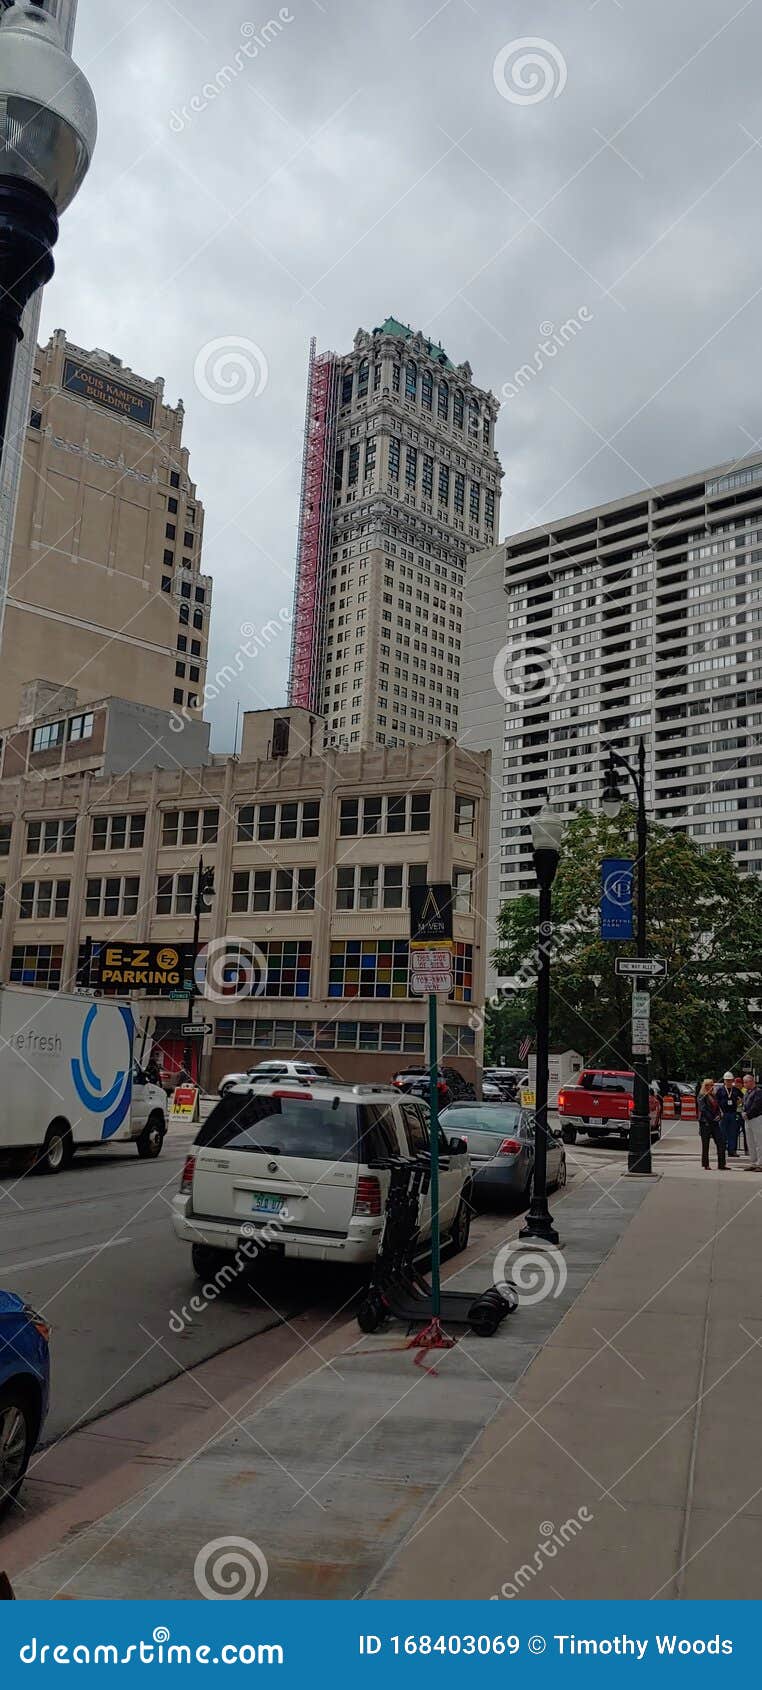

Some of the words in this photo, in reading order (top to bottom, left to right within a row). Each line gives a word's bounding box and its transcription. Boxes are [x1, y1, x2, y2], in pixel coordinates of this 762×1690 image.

[74, 369, 104, 389] LOUIS
[106, 383, 144, 408] KAMPER
[86, 385, 131, 413] BUILDING
[105, 949, 150, 967] E-Z
[102, 970, 180, 984] PARKING
